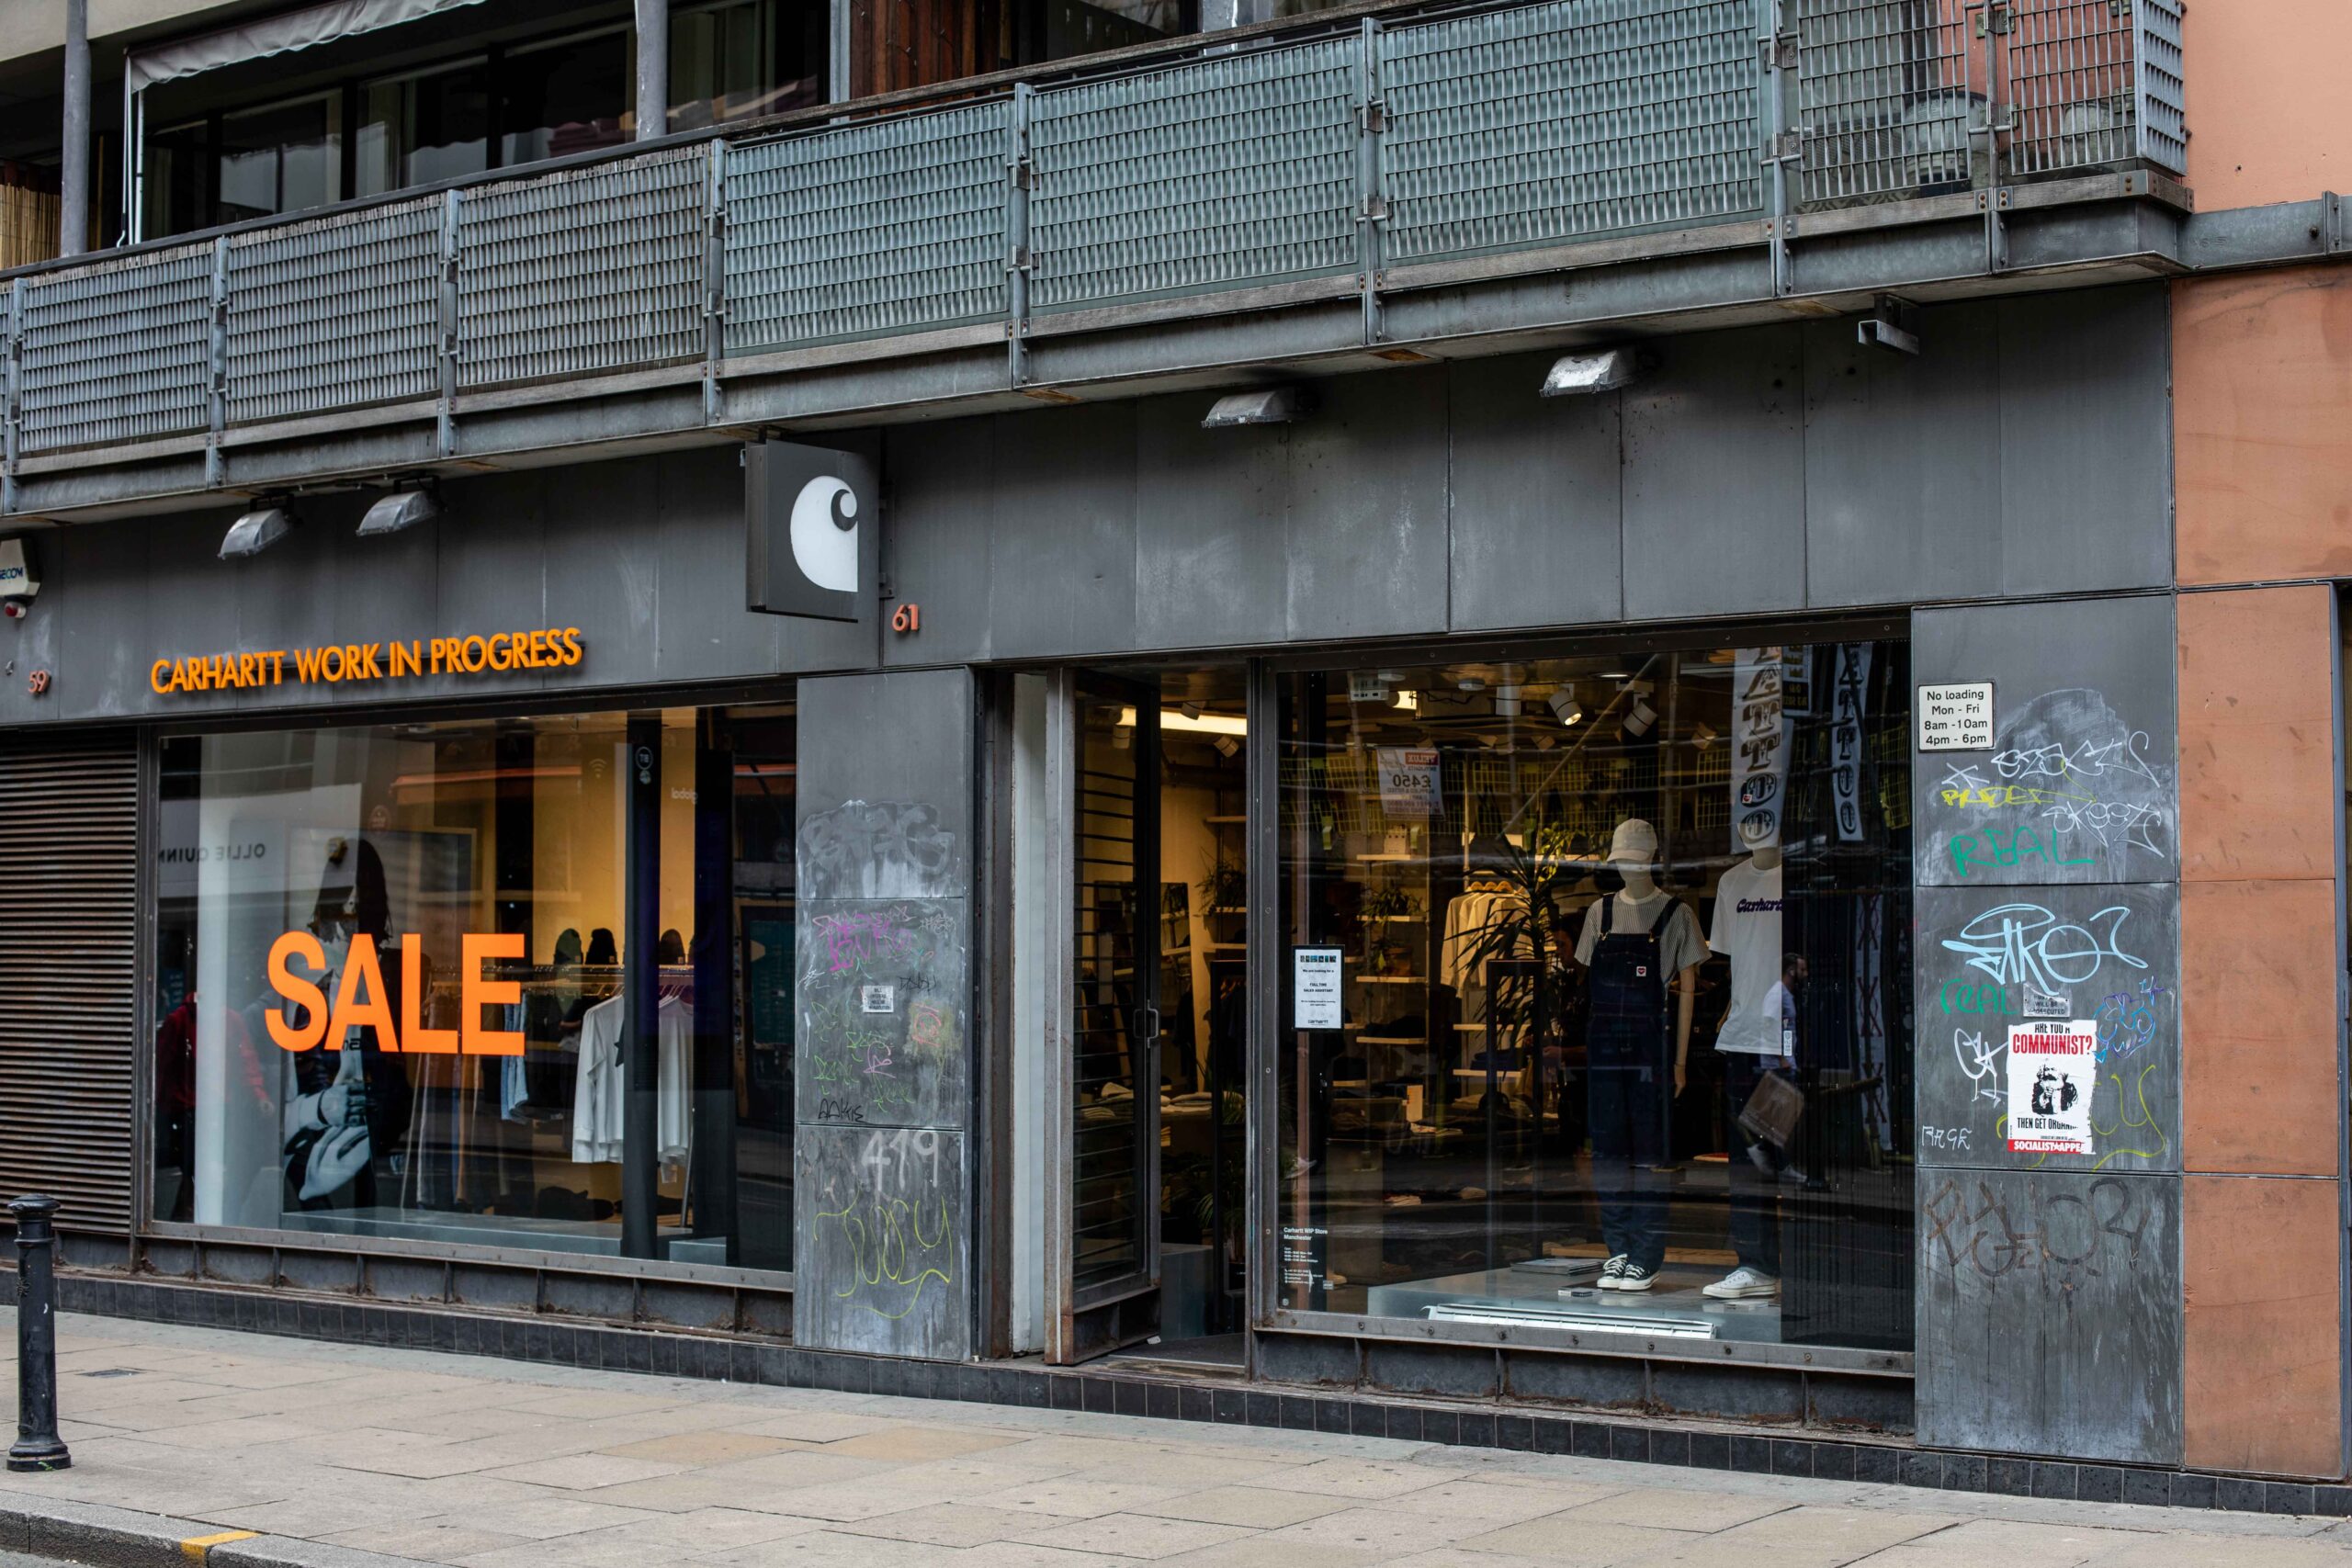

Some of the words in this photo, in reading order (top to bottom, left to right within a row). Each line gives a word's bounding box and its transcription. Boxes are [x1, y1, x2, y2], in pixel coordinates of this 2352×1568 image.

[0, 568, 24, 580] ECOM
[892, 604, 920, 632] 61
[150, 649, 286, 695] CARHARTT
[294, 642, 383, 683] WORK
[390, 637, 423, 678] IN
[429, 626, 583, 675] PROGRESS
[28, 671, 49, 694] 59
[1927, 691, 1942, 701] No
[1946, 690, 1984, 701] loading
[1931, 705, 1954, 716] Mon
[1966, 704, 1980, 714] Fri
[1924, 721, 1948, 730] 8am
[1926, 736, 1950, 746] 4pm
[1962, 734, 1986, 745] 6pm
[1950, 825, 2095, 878] REAL
[264, 930, 526, 1055] SALE
[2034, 1023, 2047, 1033] ARE
[2051, 1023, 2064, 1033] YOU
[2013, 1033, 2093, 1055] COMMUNIST?
[2018, 1117, 2033, 1129] THEN
[2034, 1118, 2047, 1130] GET
[2014, 1140, 2055, 1151] SOCIALIST
